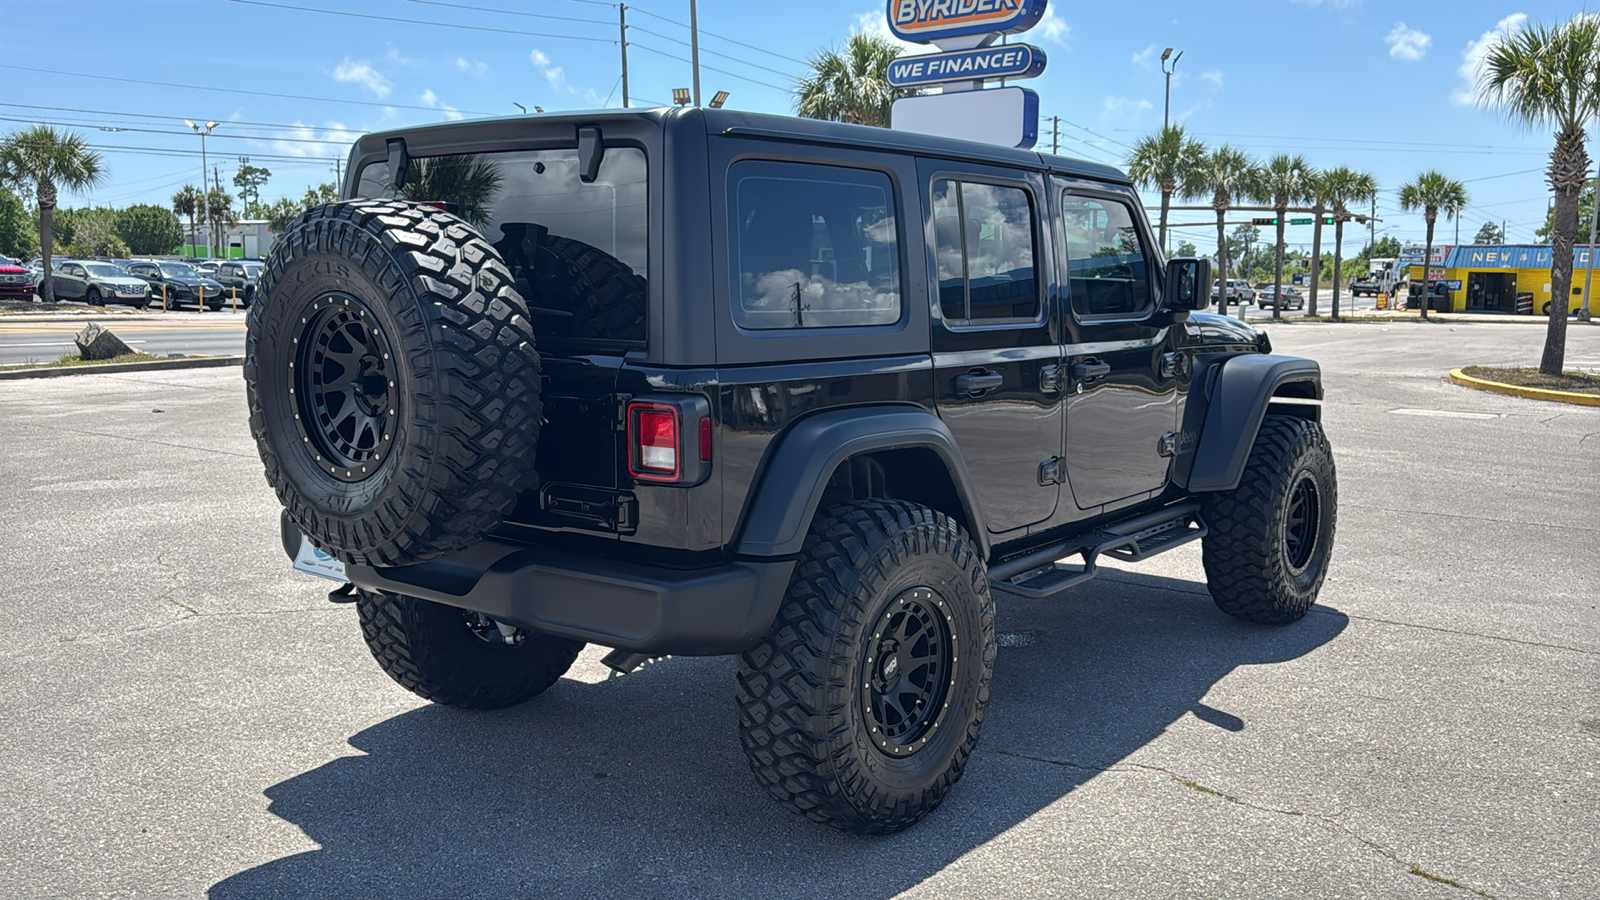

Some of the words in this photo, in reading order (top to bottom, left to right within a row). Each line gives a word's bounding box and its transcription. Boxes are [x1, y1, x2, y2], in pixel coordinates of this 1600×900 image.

[894, 62, 924, 79] WE
[927, 51, 1023, 76] FINANCE!
[1472, 252, 1511, 262] NEW
[1520, 252, 1528, 261] &
[1536, 252, 1590, 262] UD
[1180, 430, 1196, 445] Jeep
